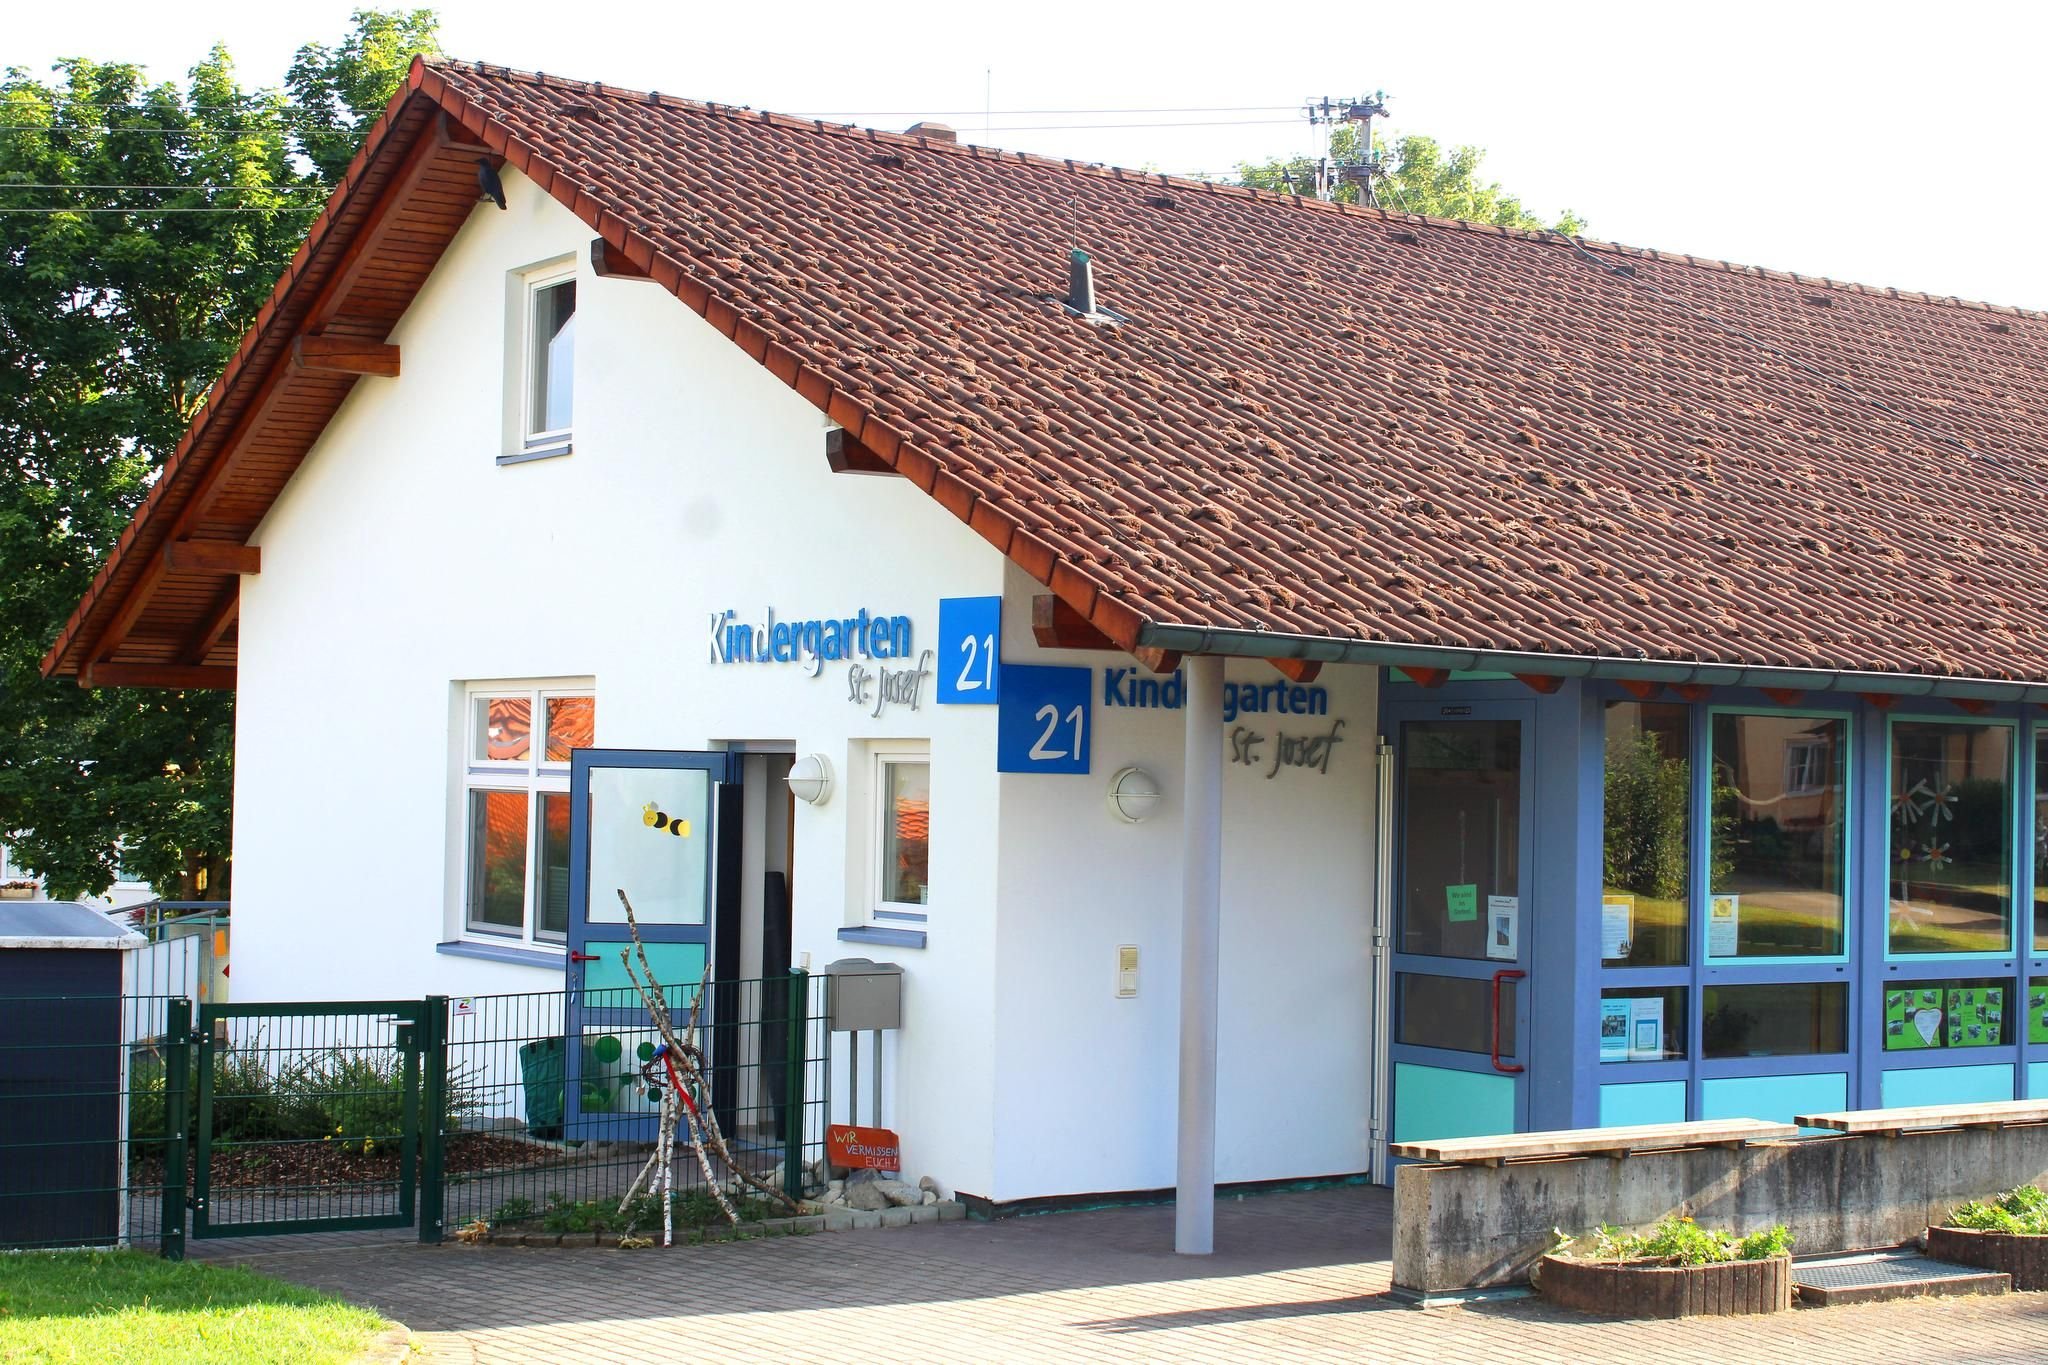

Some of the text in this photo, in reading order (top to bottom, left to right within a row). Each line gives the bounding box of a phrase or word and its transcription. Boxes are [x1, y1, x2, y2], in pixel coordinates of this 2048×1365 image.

[707, 606, 912, 678] Kindergarten
[956, 633, 994, 691] 21
[848, 649, 933, 718] St. Josef
[1104, 668, 1327, 722] Kindgarten
[1028, 703, 1083, 761] 21
[1231, 720, 1345, 779] St. Josef
[834, 1131, 857, 1144] WIR
[846, 1145, 898, 1156] VERMISSEN
